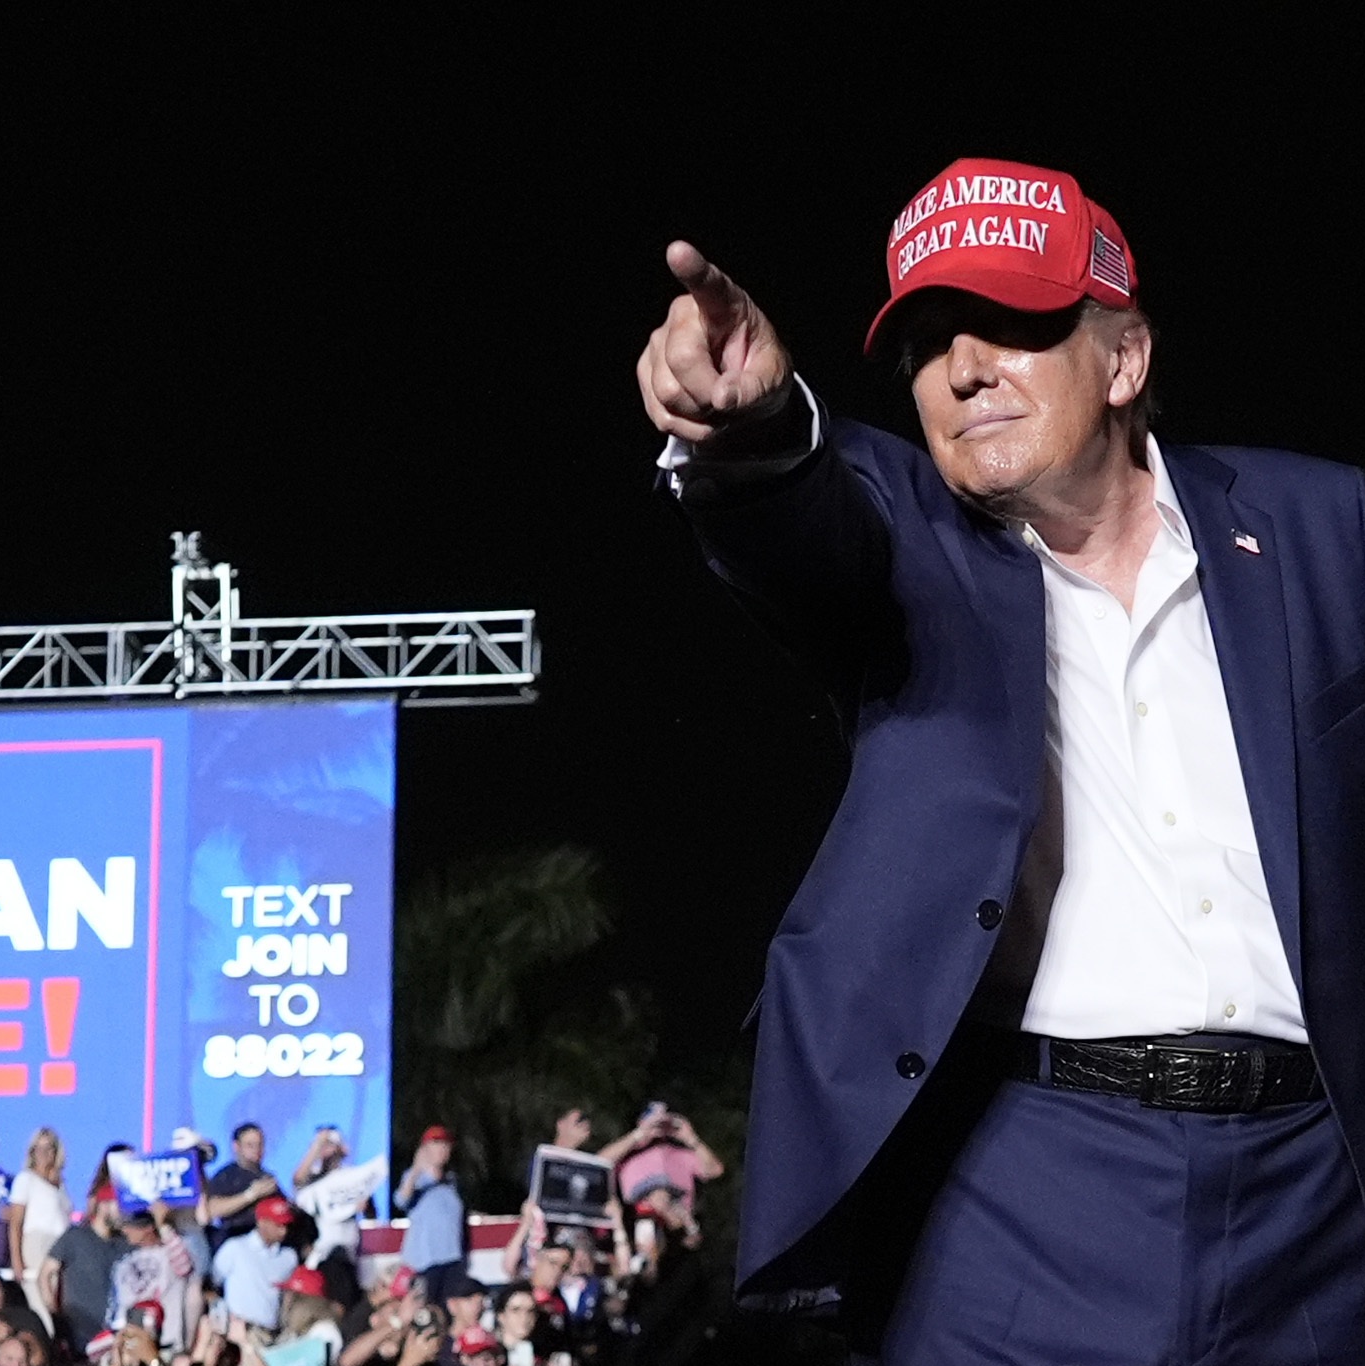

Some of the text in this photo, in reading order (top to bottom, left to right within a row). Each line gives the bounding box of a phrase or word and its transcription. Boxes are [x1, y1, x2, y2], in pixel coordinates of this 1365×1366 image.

[890, 175, 1067, 248] MAKE AMERICA
[897, 216, 1050, 280] GREAT AGAIN
[222, 882, 353, 928] TEXT
[222, 932, 348, 977] JOIN
[248, 983, 321, 1028] TO
[202, 1031, 365, 1079] 88022
